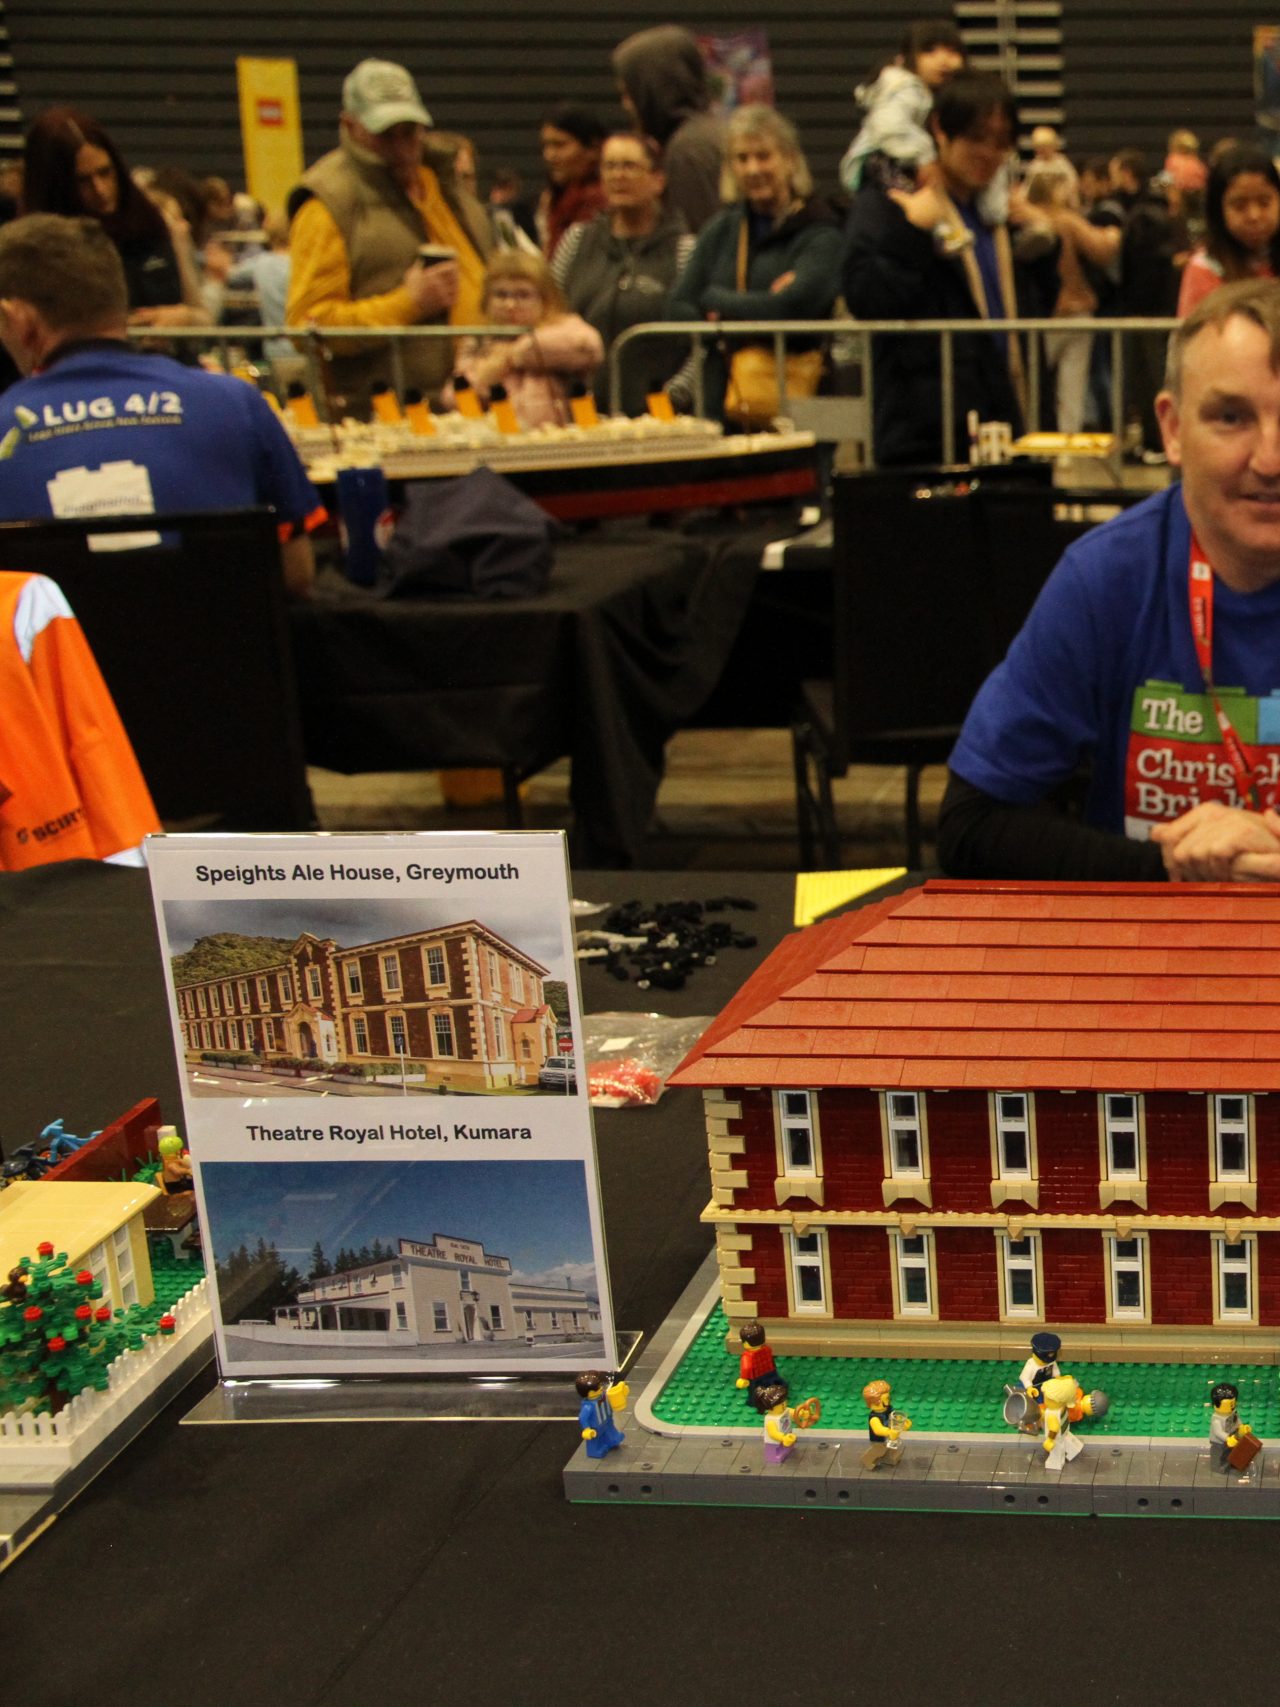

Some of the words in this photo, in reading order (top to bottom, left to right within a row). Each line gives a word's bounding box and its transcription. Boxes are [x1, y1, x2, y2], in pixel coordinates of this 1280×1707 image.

[43, 397, 116, 427] LUG
[124, 391, 184, 415] 4/2
[1142, 697, 1204, 734] The
[195, 864, 287, 886] Speights
[291, 864, 325, 881] Ale
[329, 863, 401, 883] House,
[406, 863, 519, 884] Greymouth
[245, 1125, 324, 1141] Theatre
[329, 1124, 385, 1144] Royal
[389, 1124, 448, 1142] Hotel,
[453, 1124, 532, 1140] Kumara
[410, 1244, 447, 1260] THEATRE
[454, 1252, 478, 1264] ROYAL
